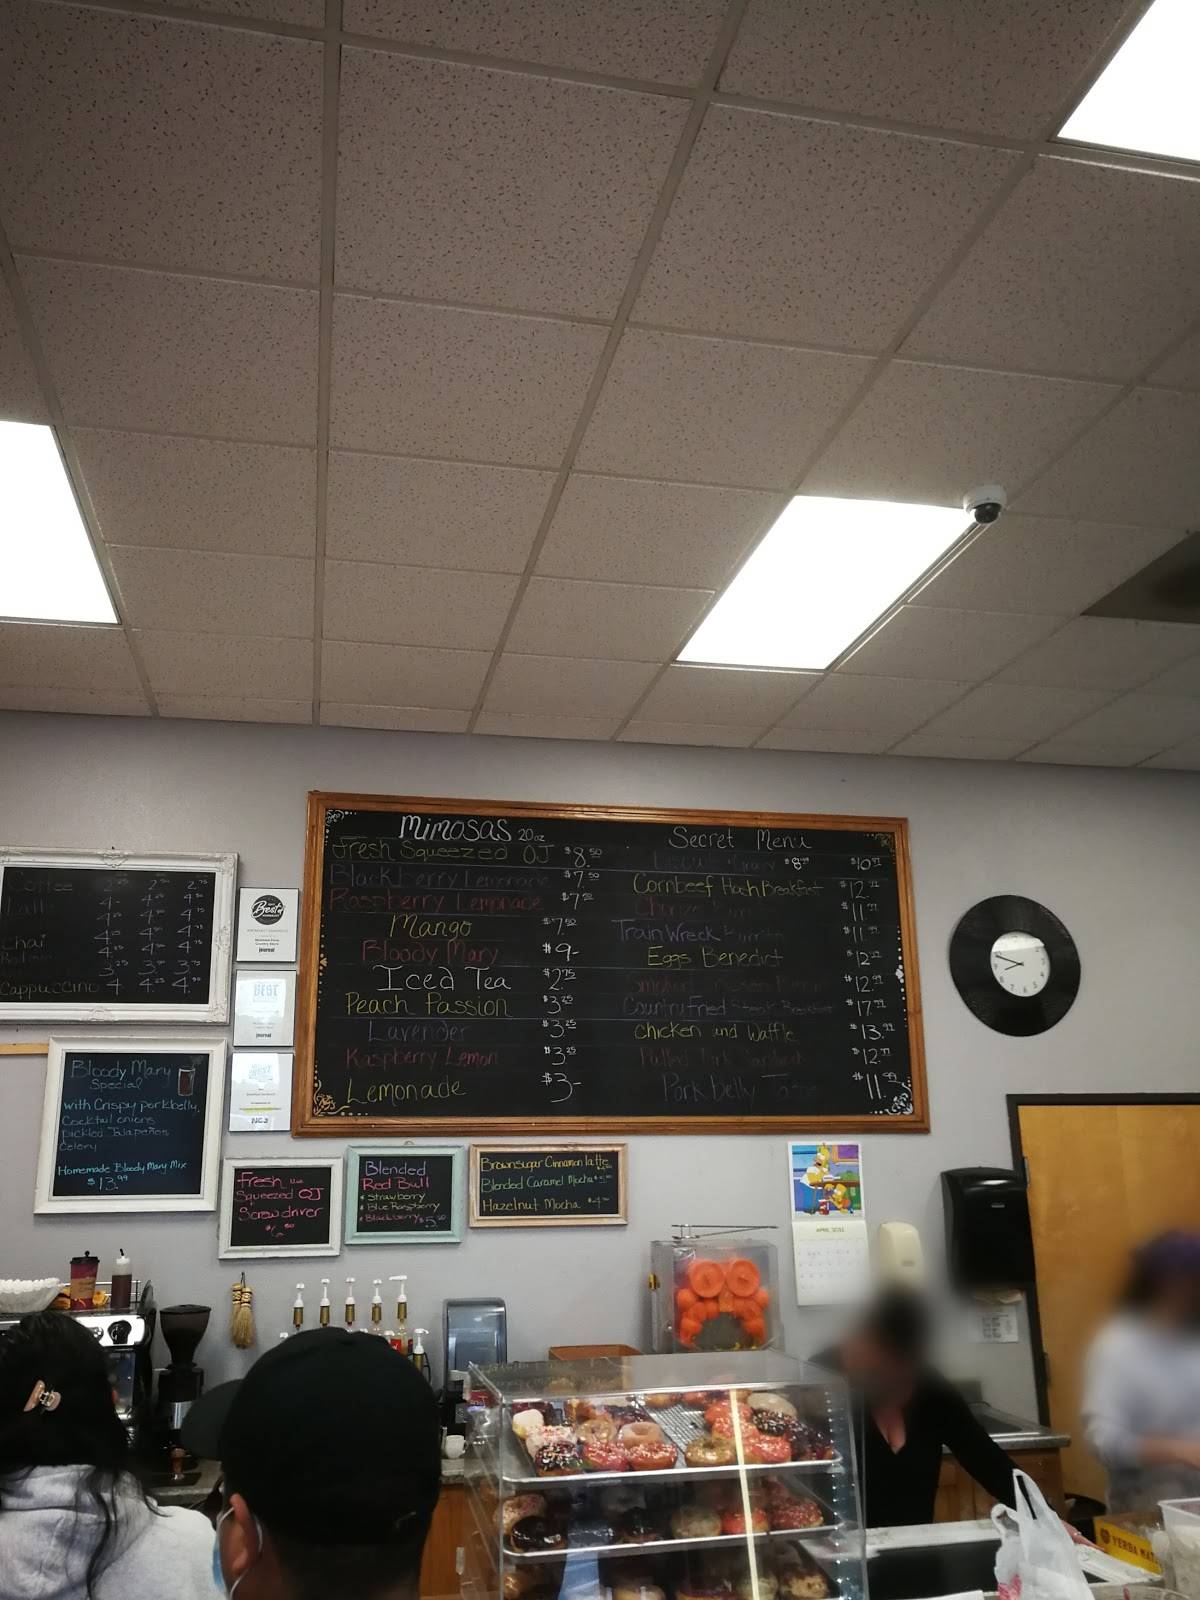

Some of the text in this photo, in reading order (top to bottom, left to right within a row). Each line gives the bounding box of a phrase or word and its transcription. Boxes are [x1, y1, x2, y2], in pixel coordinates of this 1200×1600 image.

[399, 815, 513, 842] Mimosas
[669, 826, 735, 850] Secret
[332, 840, 396, 860] Fresh
[400, 840, 508, 862] Squeezed
[388, 913, 472, 940] Mango
[647, 945, 692, 969] Eggs
[702, 947, 784, 969] Benedict
[372, 964, 455, 992] Iced
[465, 965, 512, 991] Tea
[345, 992, 416, 1015] Peach
[425, 993, 514, 1018] Passion
[368, 1020, 473, 1042] Lavender
[445, 1046, 499, 1066] Lemon
[70, 1059, 171, 1085] Bloody Mary
[90, 1077, 143, 1091] Special
[347, 1077, 467, 1107] Lemonade
[63, 1099, 91, 1111] with
[93, 1098, 137, 1114] Crispy
[62, 1114, 113, 1127] Cocktail
[57, 1163, 111, 1177] Homemade
[115, 1162, 145, 1176] Bloody
[168, 1160, 188, 1170] Mix
[365, 1158, 427, 1177] Blended
[545, 1155, 584, 1168] Cinnamon
[237, 1172, 288, 1190] Fresh
[362, 1177, 430, 1191] Red Bull
[481, 1175, 524, 1194] Blended
[527, 1175, 565, 1188] Caramel
[236, 1187, 294, 1207] Squeezed
[367, 1201, 441, 1213] Blue Raspberry
[483, 1196, 541, 1213] Hazelnut
[544, 1197, 582, 1212] Mocha
[1112, 1535, 1139, 1556] YERBA
